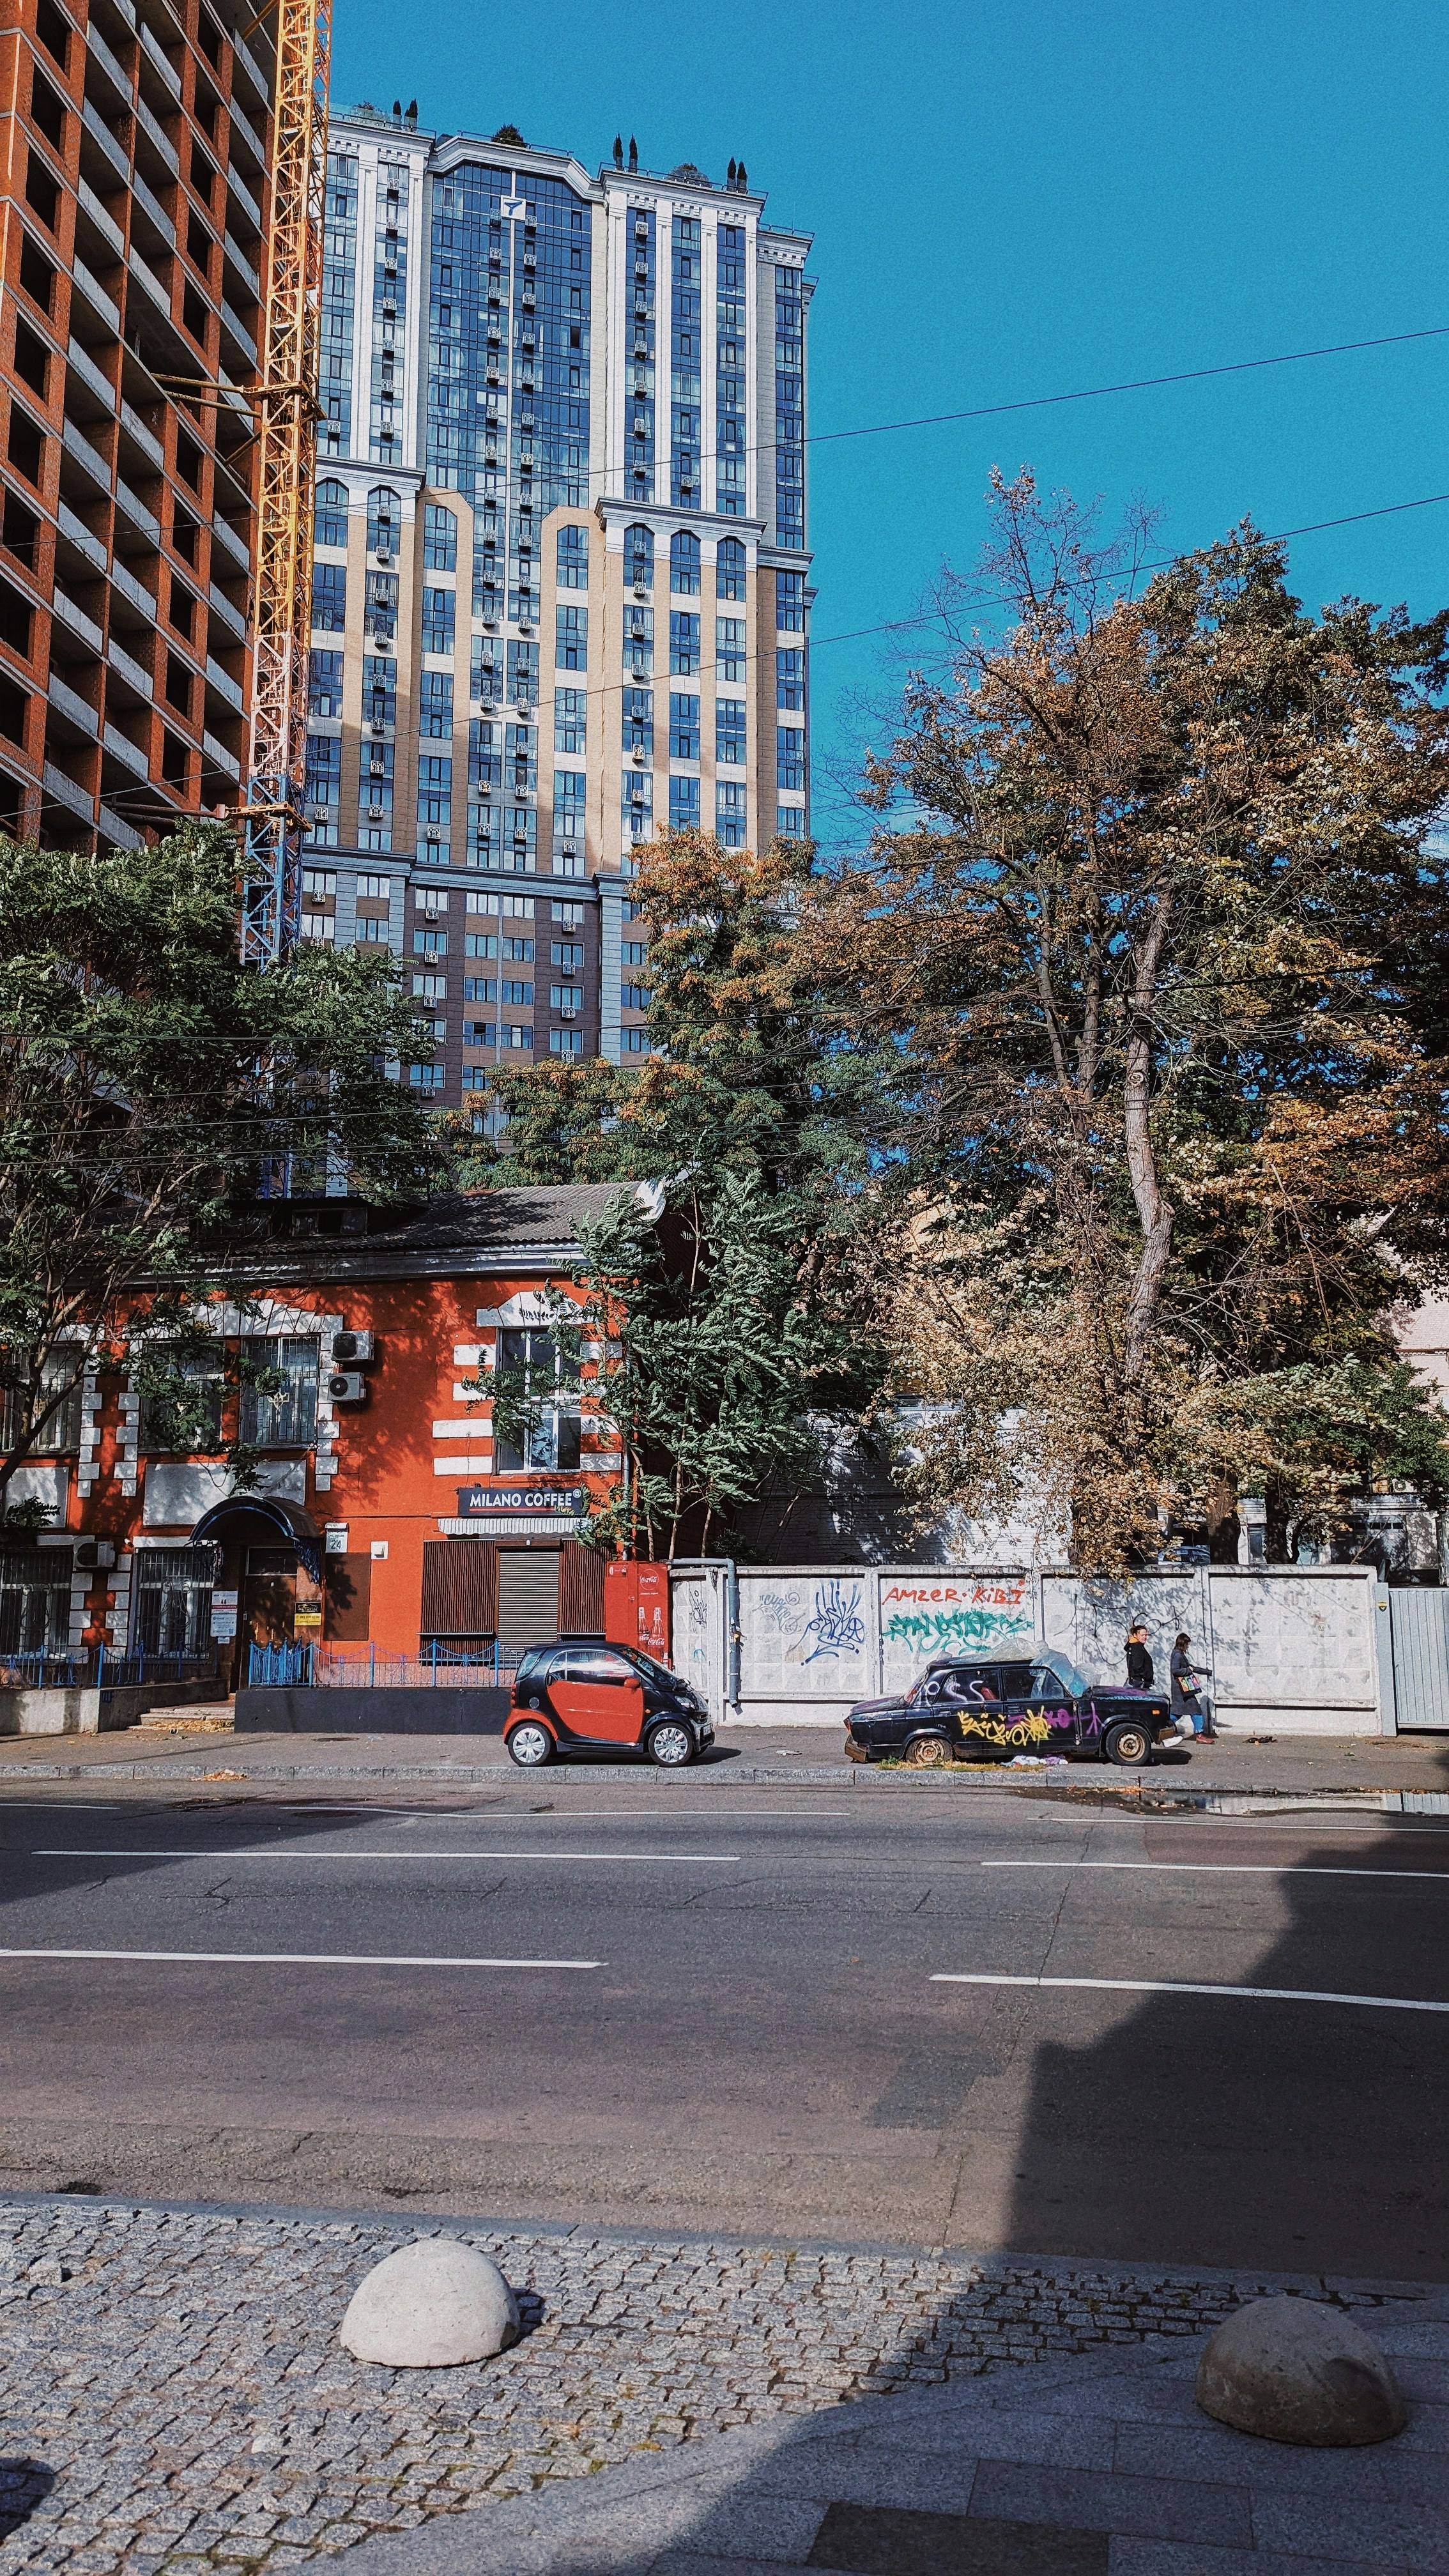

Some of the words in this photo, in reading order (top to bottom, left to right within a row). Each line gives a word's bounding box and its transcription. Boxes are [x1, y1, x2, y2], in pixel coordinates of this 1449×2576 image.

[470, 1492, 521, 1507] MILANO
[525, 1492, 572, 1507] COFFEE
[330, 1540, 341, 1549] 24
